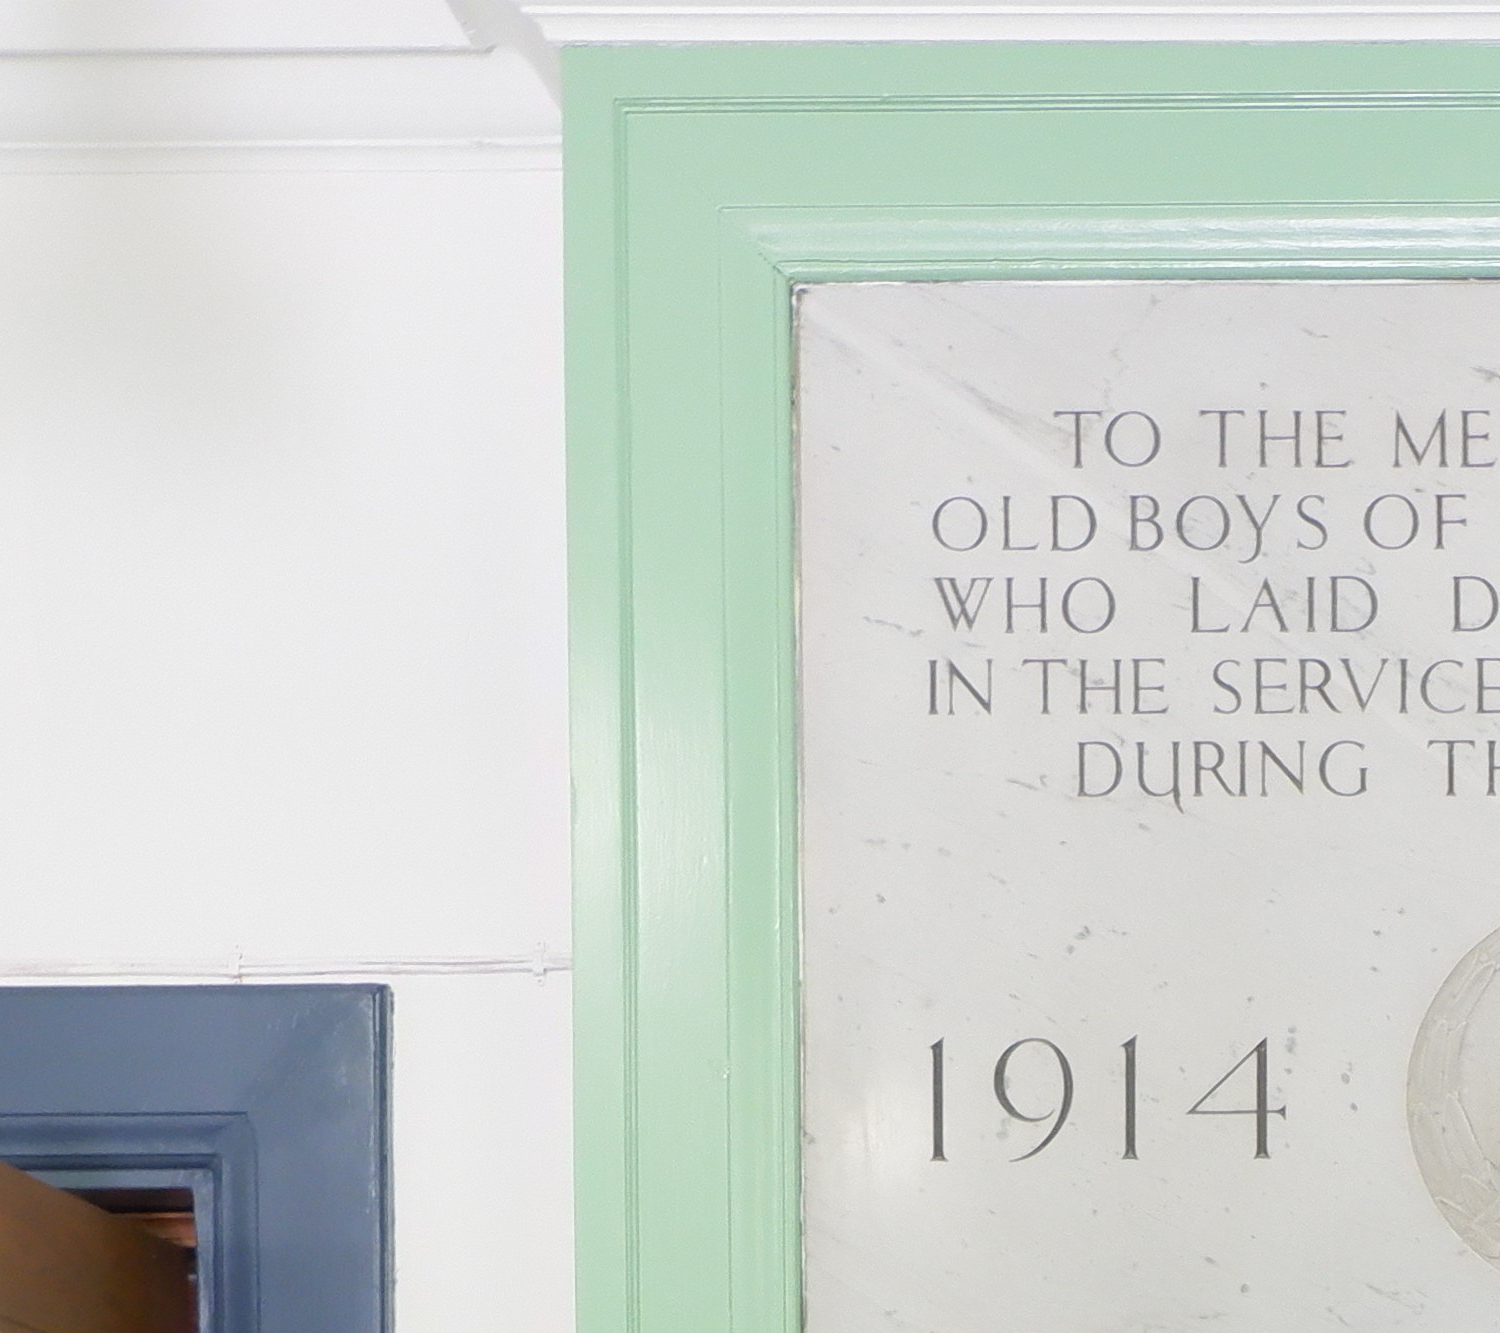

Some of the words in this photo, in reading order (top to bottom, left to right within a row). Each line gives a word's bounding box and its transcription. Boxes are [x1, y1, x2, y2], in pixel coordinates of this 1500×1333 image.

[1052, 409, 1163, 470] TO
[1198, 409, 1353, 470] THE
[930, 491, 1098, 552] OLD
[1126, 491, 1330, 565] BOYS
[1363, 491, 1469, 552] OF
[933, 576, 1116, 636] WHO
[1188, 575, 1382, 634] LAID
[928, 658, 996, 716] IN
[1021, 657, 1171, 716] THE
[1073, 738, 1371, 811] DURING
[928, 1033, 1289, 1164] 1914
